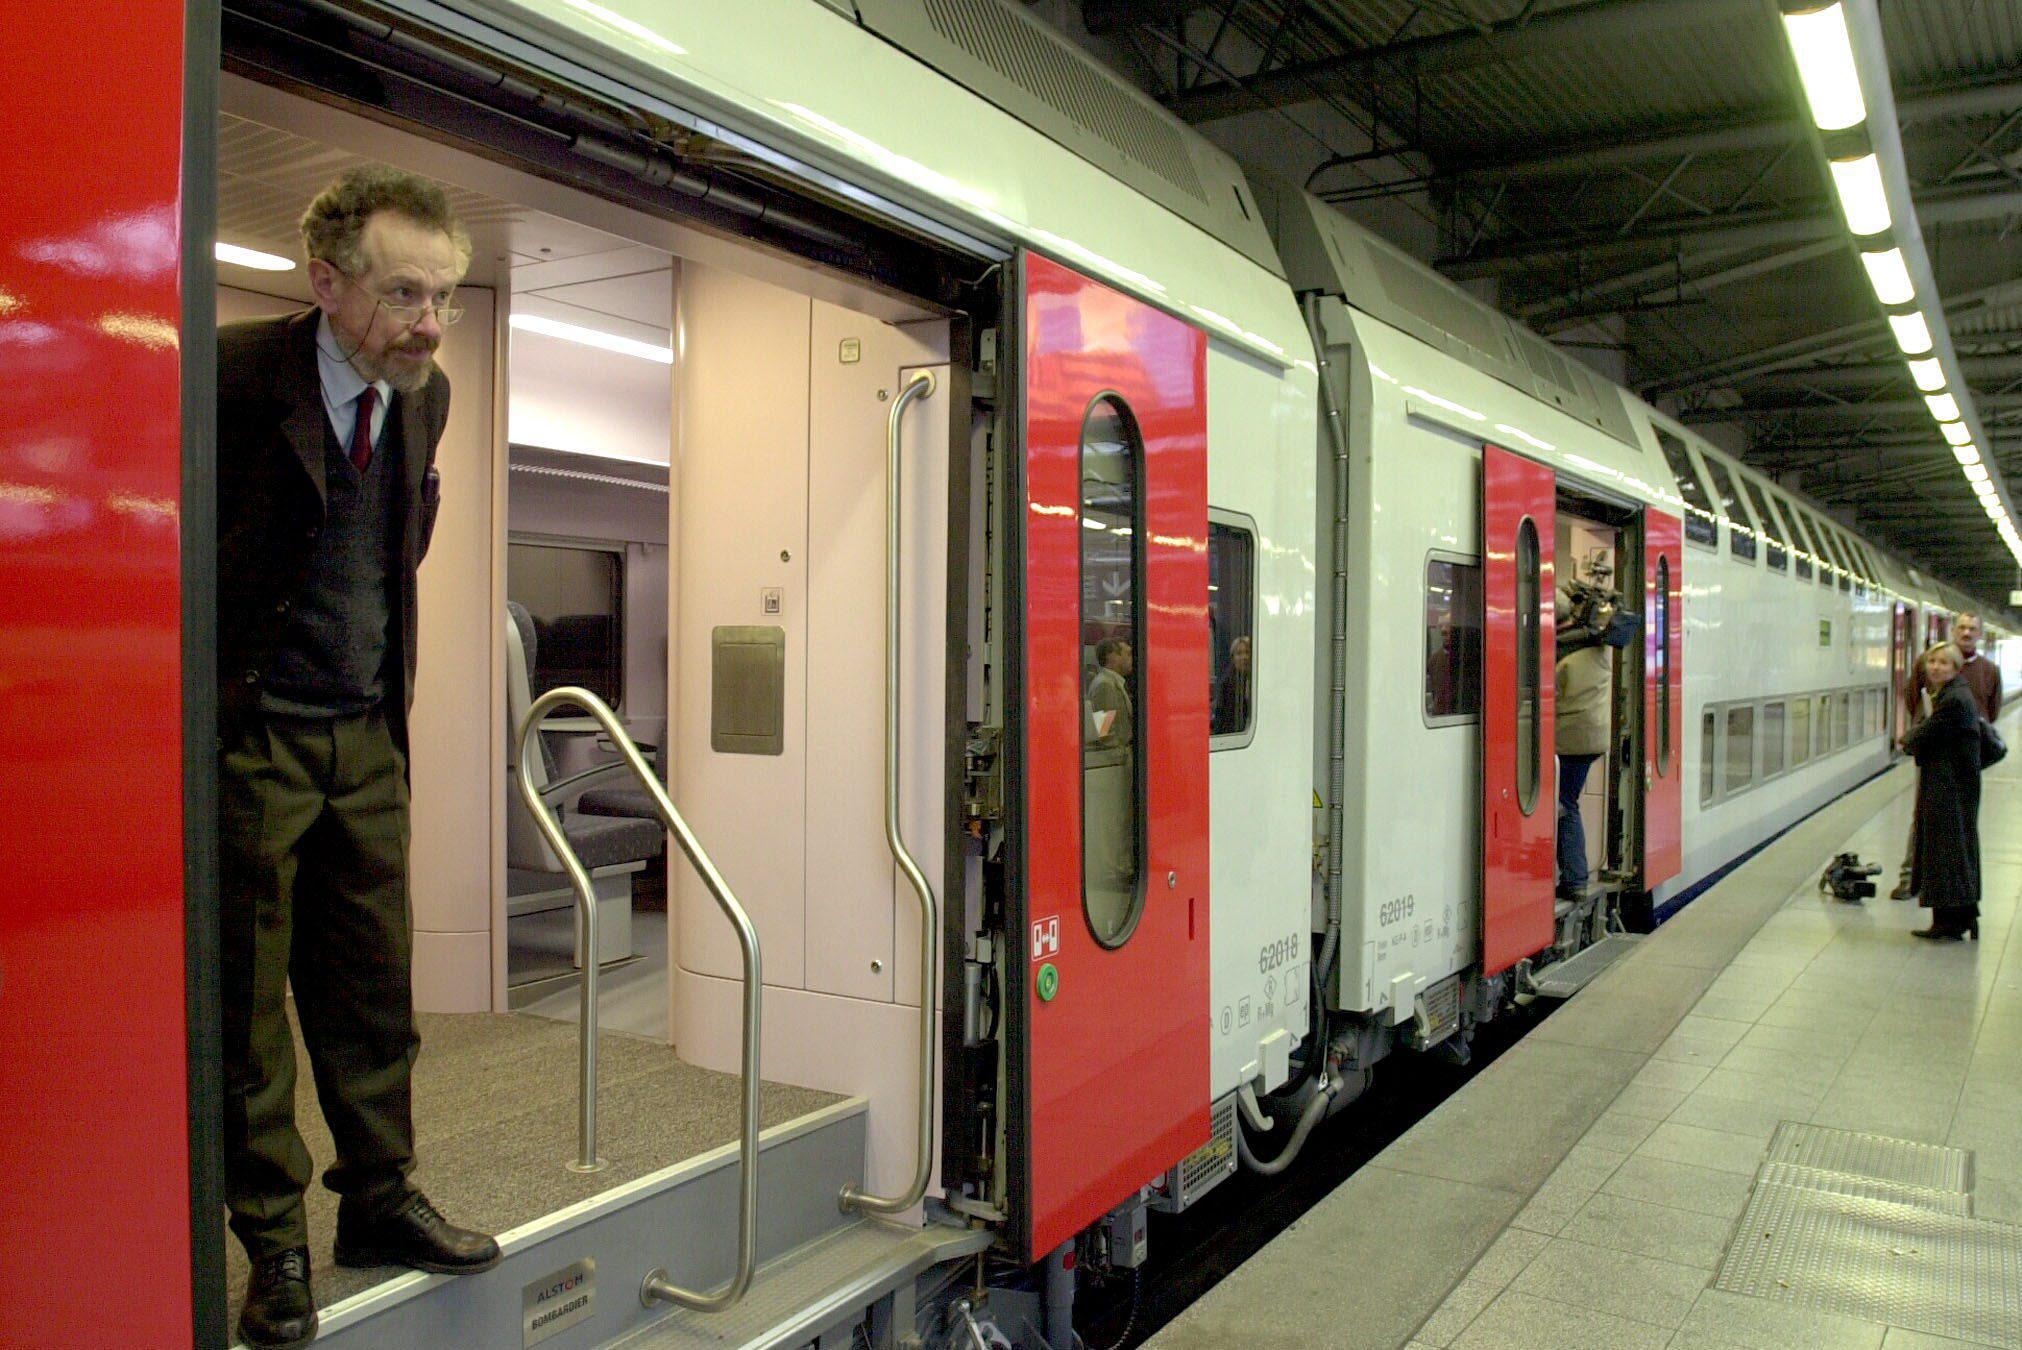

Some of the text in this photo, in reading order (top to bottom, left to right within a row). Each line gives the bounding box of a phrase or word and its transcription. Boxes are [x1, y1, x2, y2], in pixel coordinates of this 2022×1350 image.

[1380, 894, 1414, 927] 62019
[1259, 933, 1298, 974] 62018
[537, 1273, 583, 1304] ALSTOM
[532, 1295, 588, 1330] BOMBARDIER
